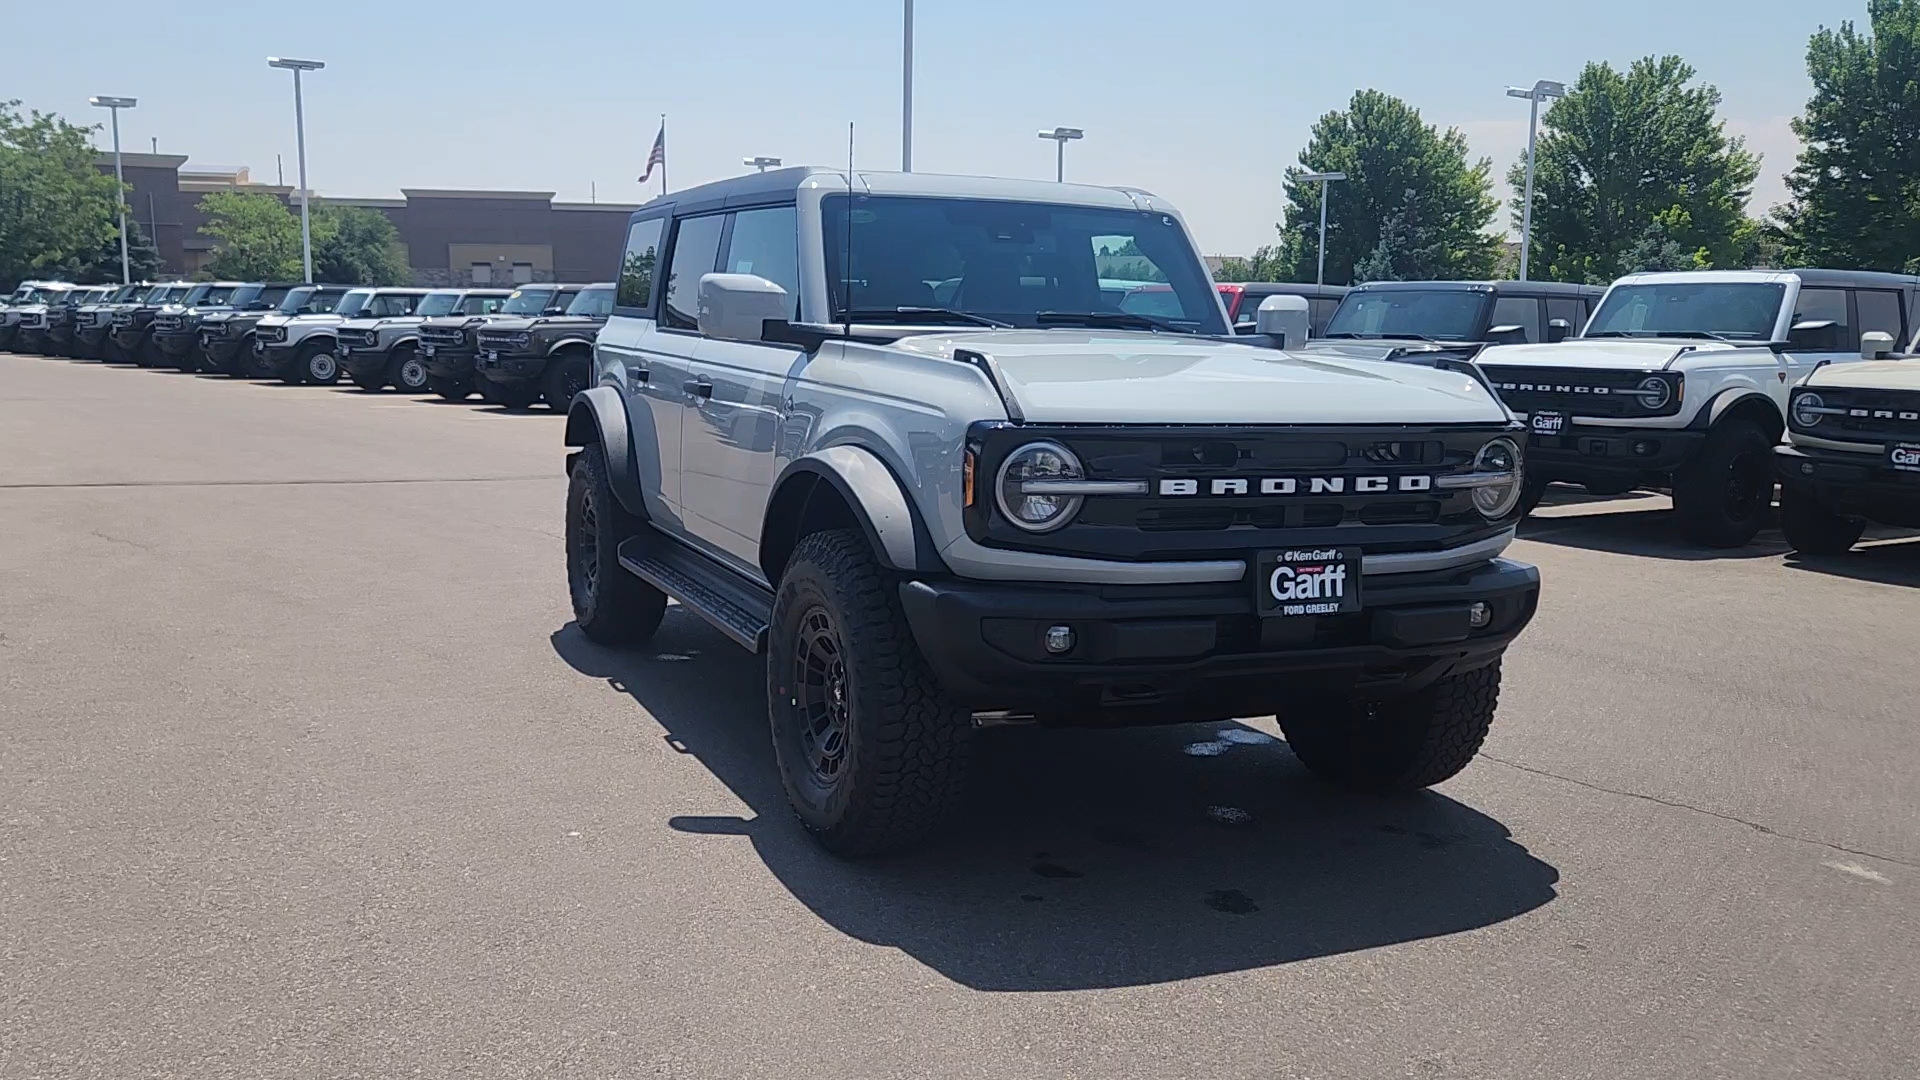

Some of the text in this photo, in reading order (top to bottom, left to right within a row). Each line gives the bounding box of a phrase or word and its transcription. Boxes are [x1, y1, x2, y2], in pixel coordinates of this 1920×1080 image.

[1502, 383, 1609, 395] BRONCO
[1532, 415, 1563, 430] Garff
[1159, 475, 1431, 495] BRONCO
[1270, 563, 1346, 600] Garff
[1284, 602, 1340, 615] FORD GREELEY
